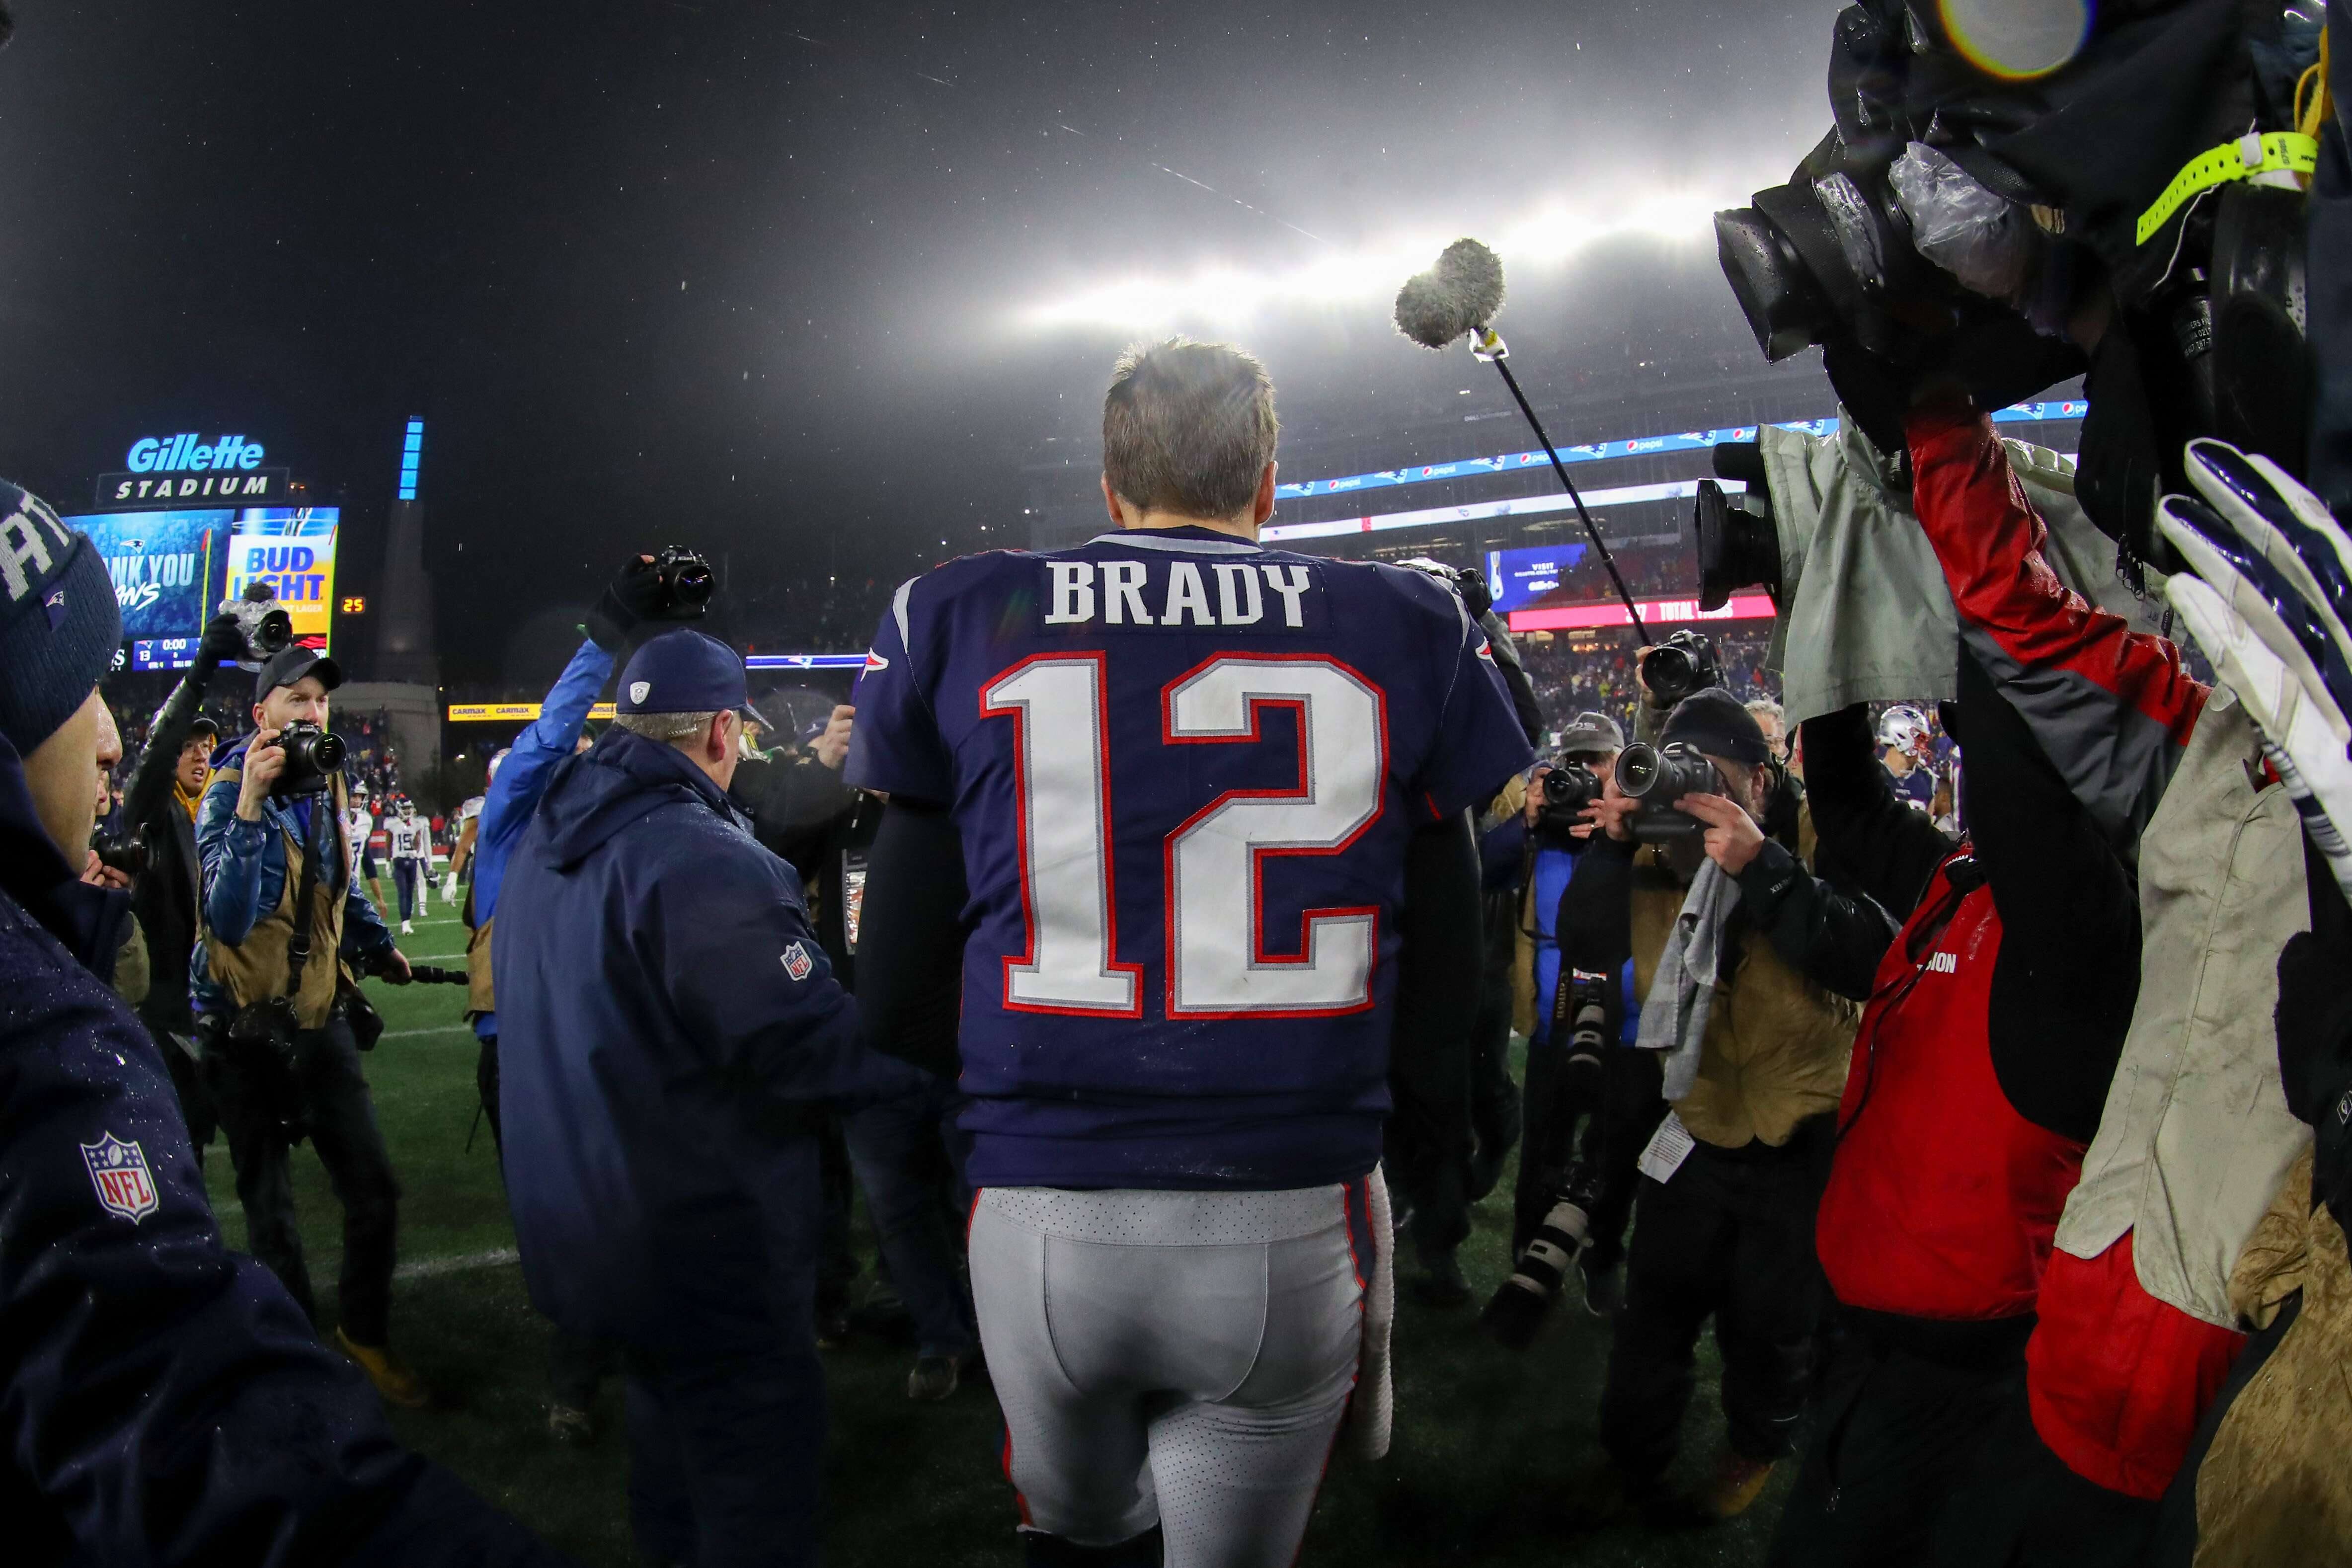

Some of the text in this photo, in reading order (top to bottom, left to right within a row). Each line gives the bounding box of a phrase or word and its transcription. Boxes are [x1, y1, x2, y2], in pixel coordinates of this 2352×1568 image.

[127, 433, 264, 472] Gillette
[1639, 439, 1663, 451] pepsi
[1532, 453, 1550, 463] pep
[1433, 465, 1456, 476] pepsi
[115, 476, 268, 499] STADIUM
[1340, 478, 1361, 488] pepsi
[246, 547, 314, 573] BUD
[1532, 562, 1554, 571] VISIT
[149, 552, 195, 587] YOU
[1044, 560, 1311, 628] BRADY
[343, 598, 364, 612] 25
[1659, 601, 1695, 621] TOTAL
[162, 638, 187, 650] 0:00
[139, 650, 151, 662] 13
[398, 833, 413, 851] 15
[979, 650, 1388, 1020] 12
[791, 957, 809, 975] NFL
[1916, 951, 1957, 973] ION
[99, 1171, 151, 1209] NFL
